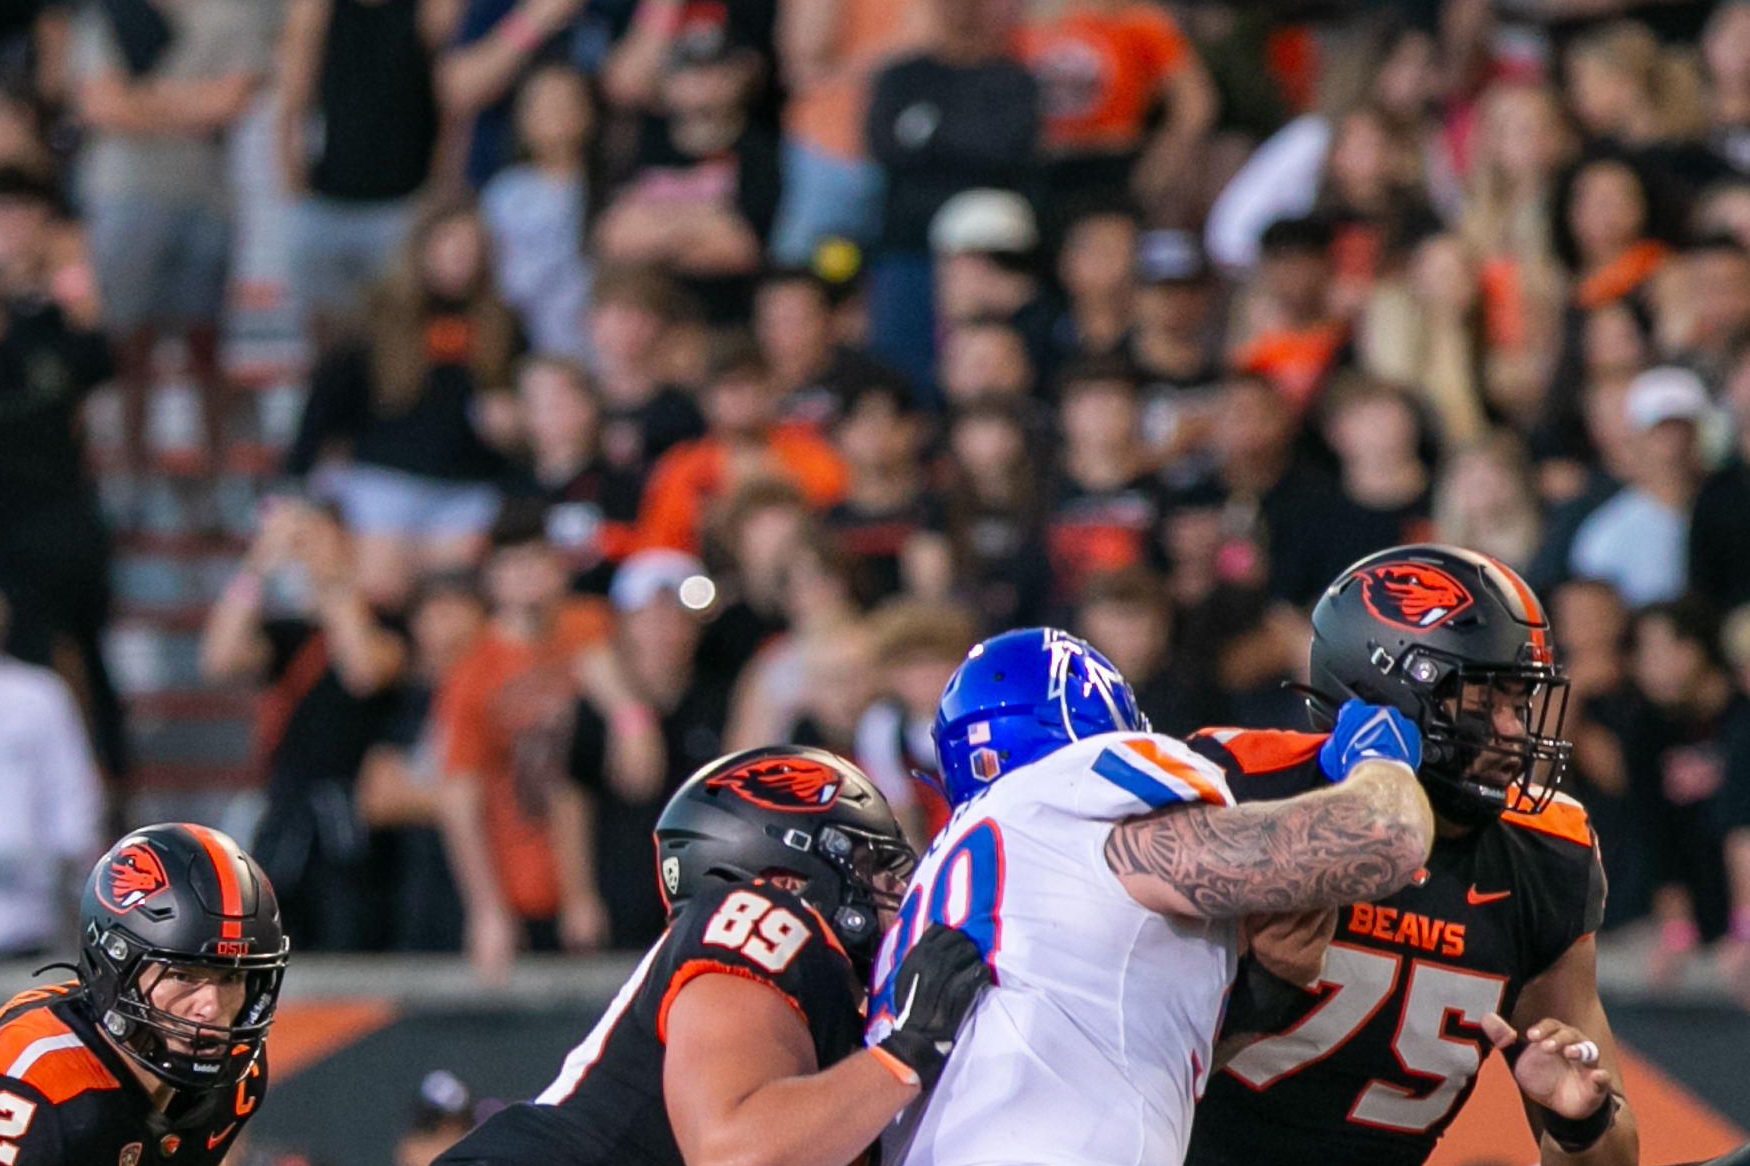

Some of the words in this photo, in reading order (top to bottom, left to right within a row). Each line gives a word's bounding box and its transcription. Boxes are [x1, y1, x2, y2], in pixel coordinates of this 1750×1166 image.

[217, 941, 249, 957] OSU
[702, 888, 813, 974] 89
[1348, 902, 1466, 957] BEAVS
[1223, 940, 1510, 1134] 75
